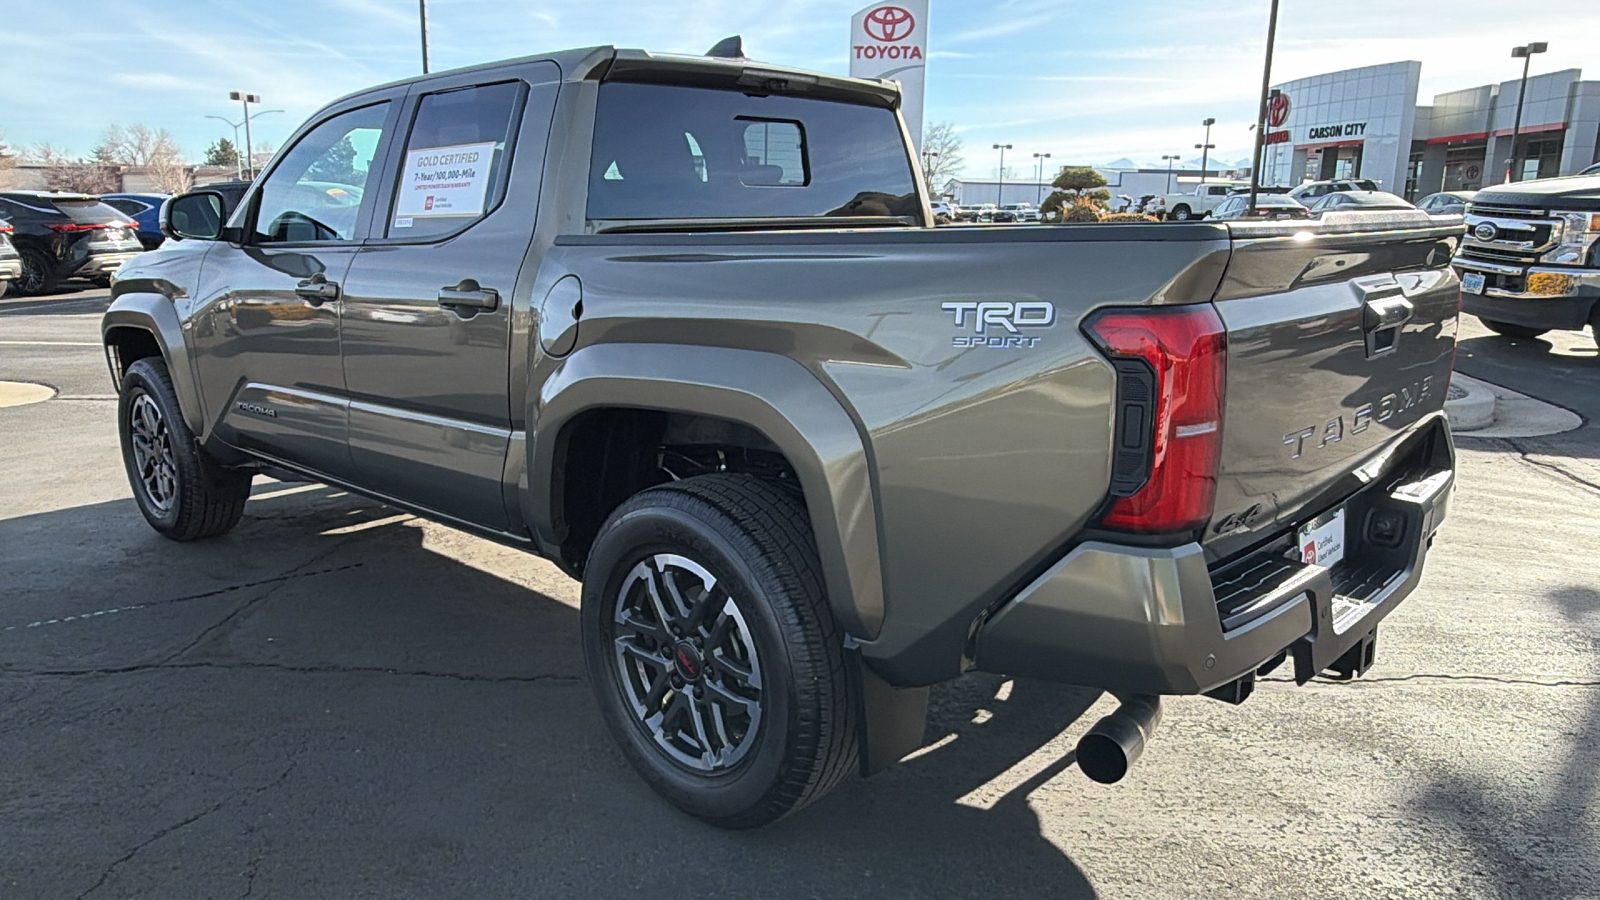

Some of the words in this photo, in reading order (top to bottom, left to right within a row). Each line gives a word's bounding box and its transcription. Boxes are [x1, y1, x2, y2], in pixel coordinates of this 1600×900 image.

[853, 45, 922, 59] TOYOTA
[1309, 125, 1343, 139] CARSON
[1345, 122, 1367, 136] CITY
[417, 155, 438, 167] GOLD
[439, 152, 479, 166] CERTIFIED
[414, 168, 476, 182] 7-Year/100,000-Mile
[941, 301, 1056, 335] TRD
[952, 336, 1041, 348] SPORT
[236, 402, 278, 418] TACOMA
[1283, 375, 1434, 460] TACOMA
[1317, 533, 1333, 550] Certified
